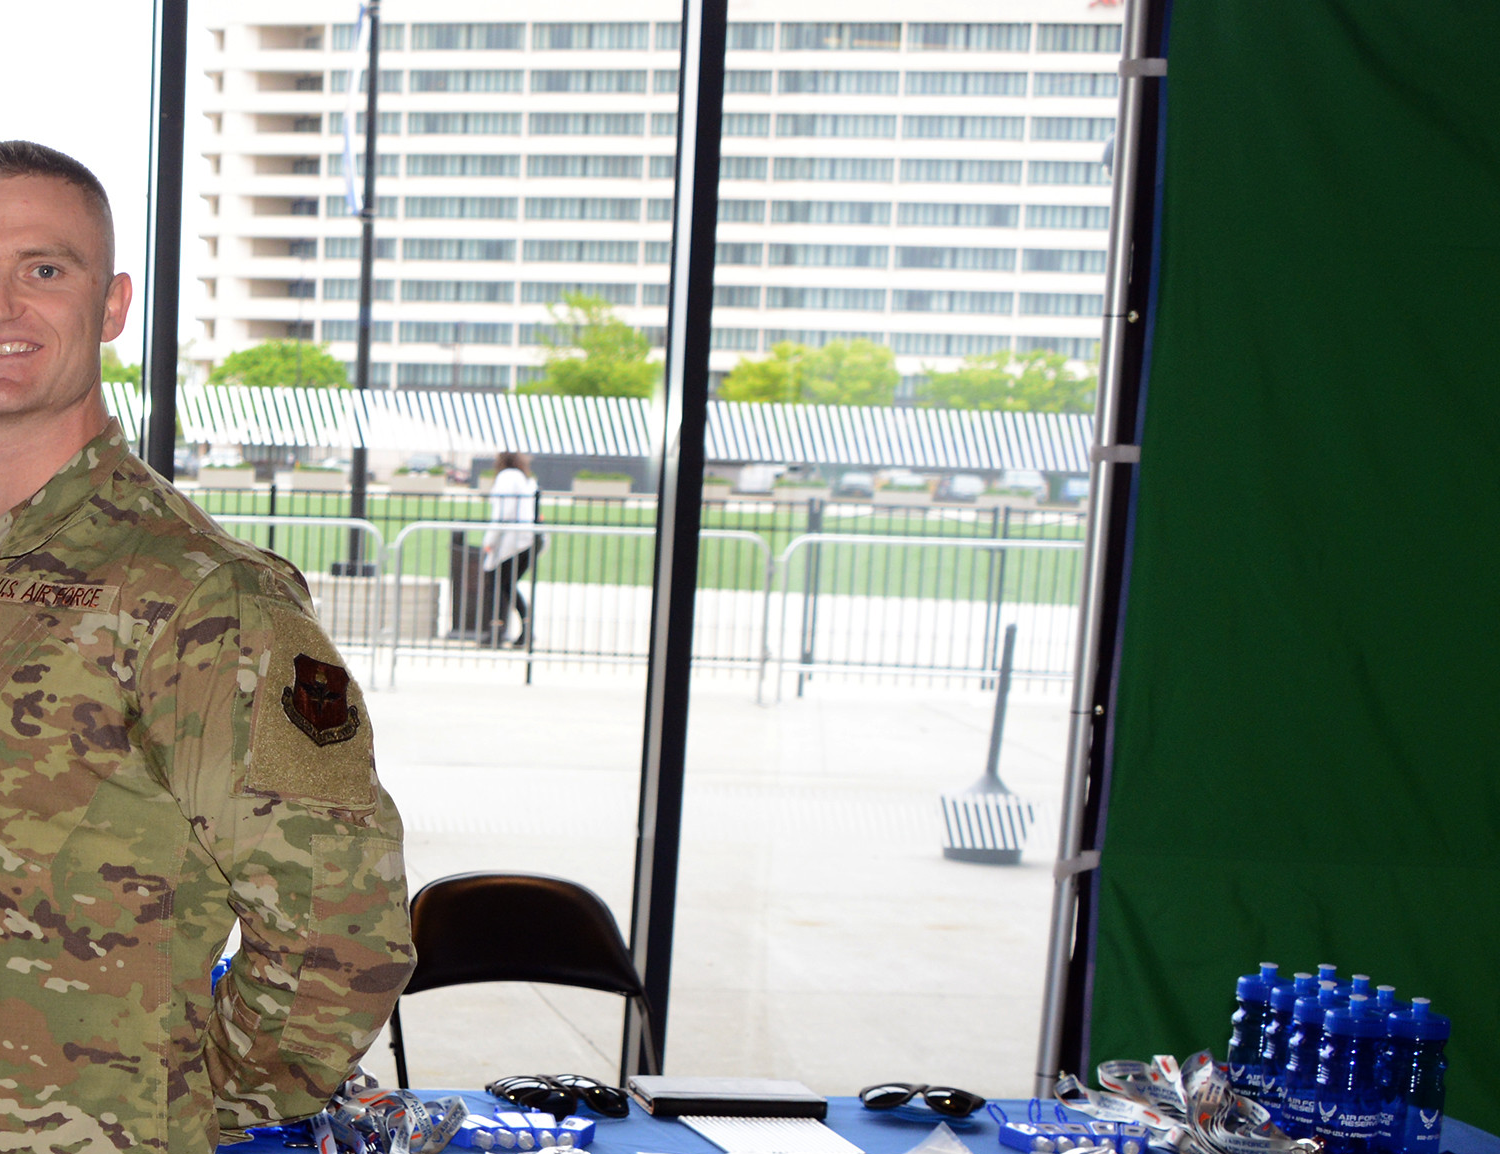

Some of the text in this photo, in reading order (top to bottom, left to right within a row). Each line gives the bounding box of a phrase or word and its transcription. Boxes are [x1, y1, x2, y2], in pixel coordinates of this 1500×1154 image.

[20, 582, 52, 604] AIR
[53, 586, 104, 608] FORCE
[1339, 1113, 1357, 1121] AIR
